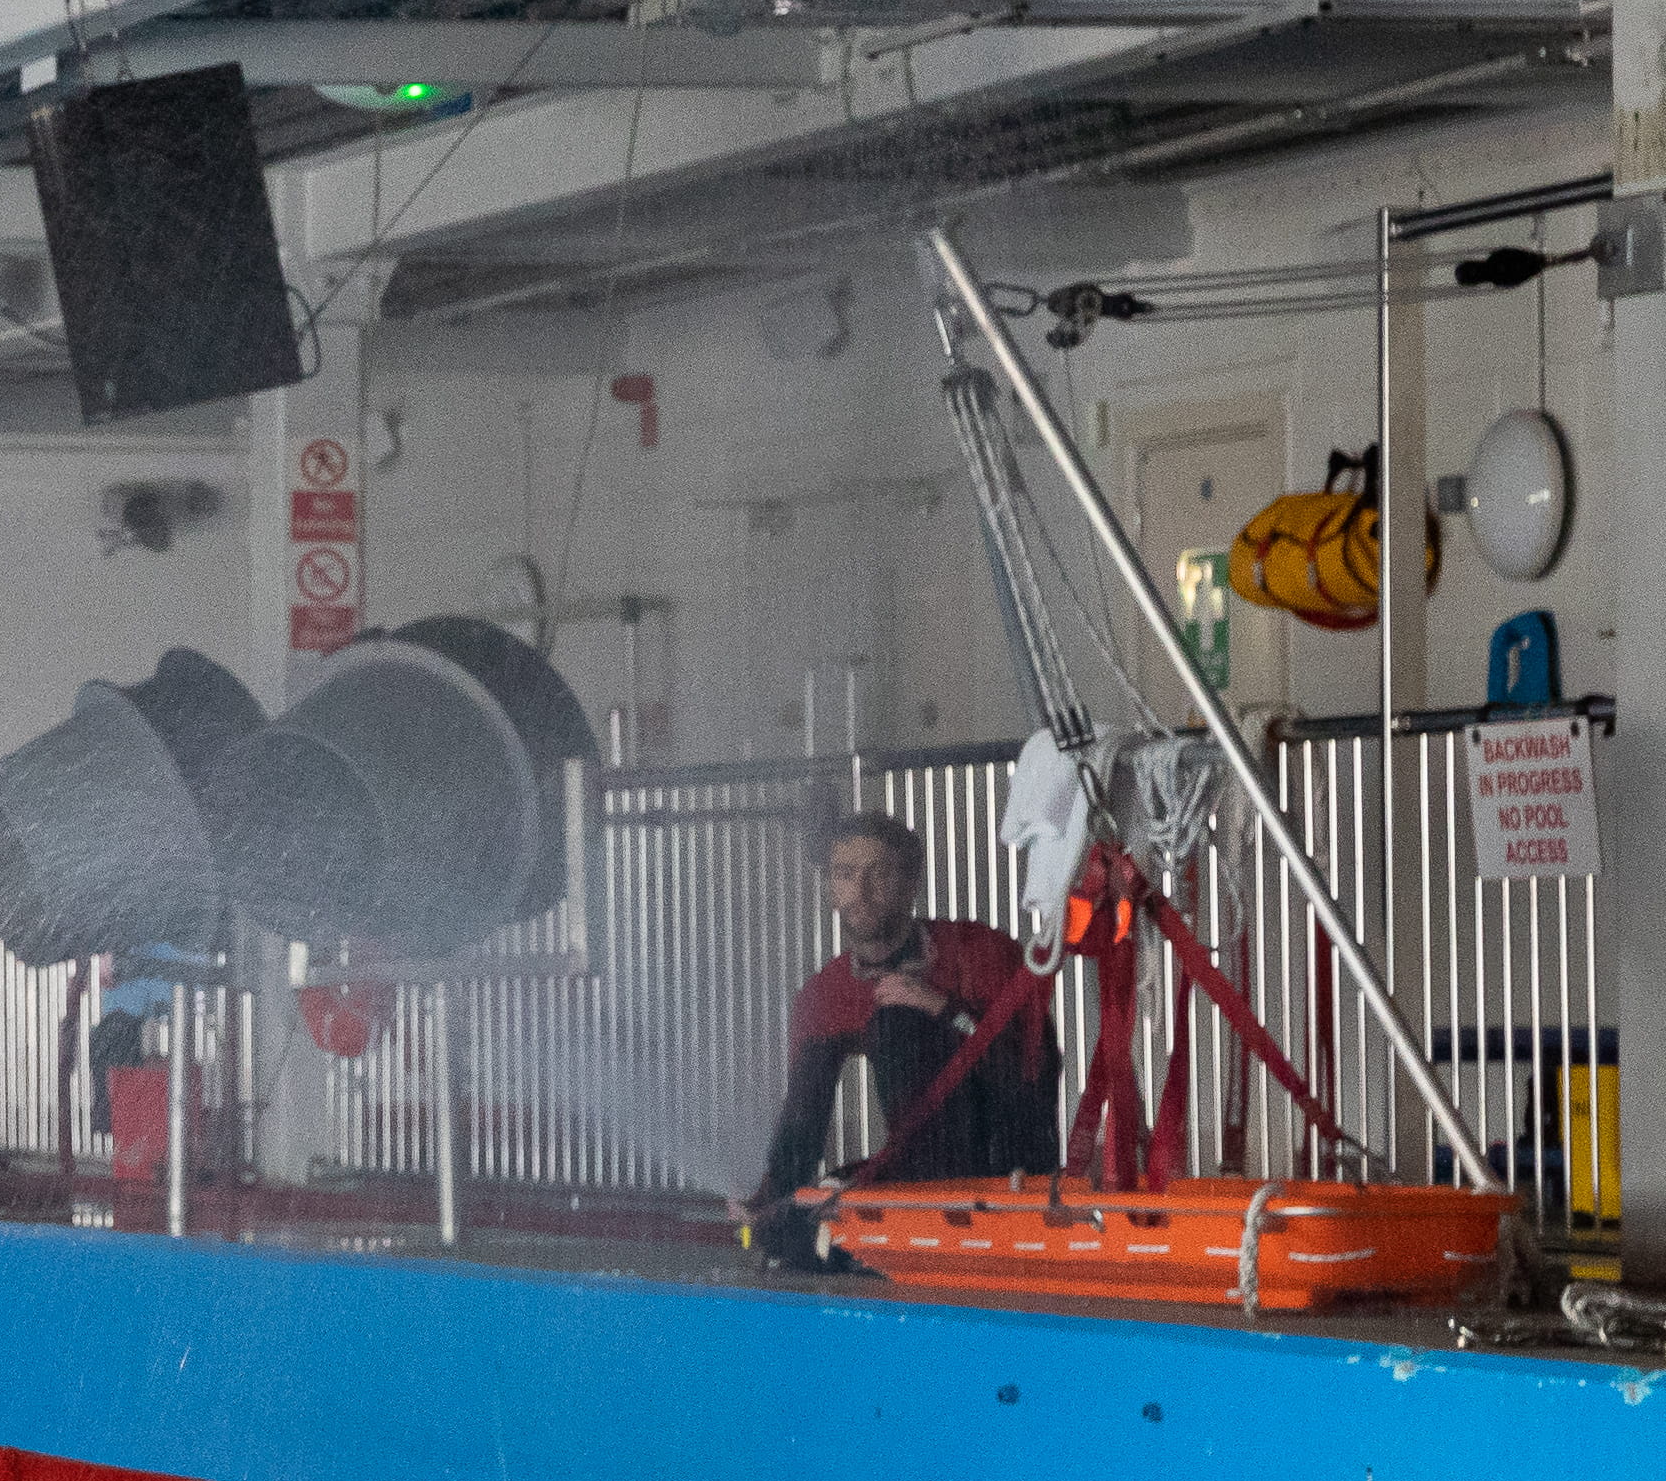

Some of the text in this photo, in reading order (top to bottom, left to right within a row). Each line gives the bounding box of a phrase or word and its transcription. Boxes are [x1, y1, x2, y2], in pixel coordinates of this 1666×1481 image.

[1482, 734, 1571, 764] BACKWASH
[1478, 768, 1584, 797] IN PROGRESS
[1498, 803, 1571, 831] NO POOL
[1505, 837, 1569, 865] ACCESS
